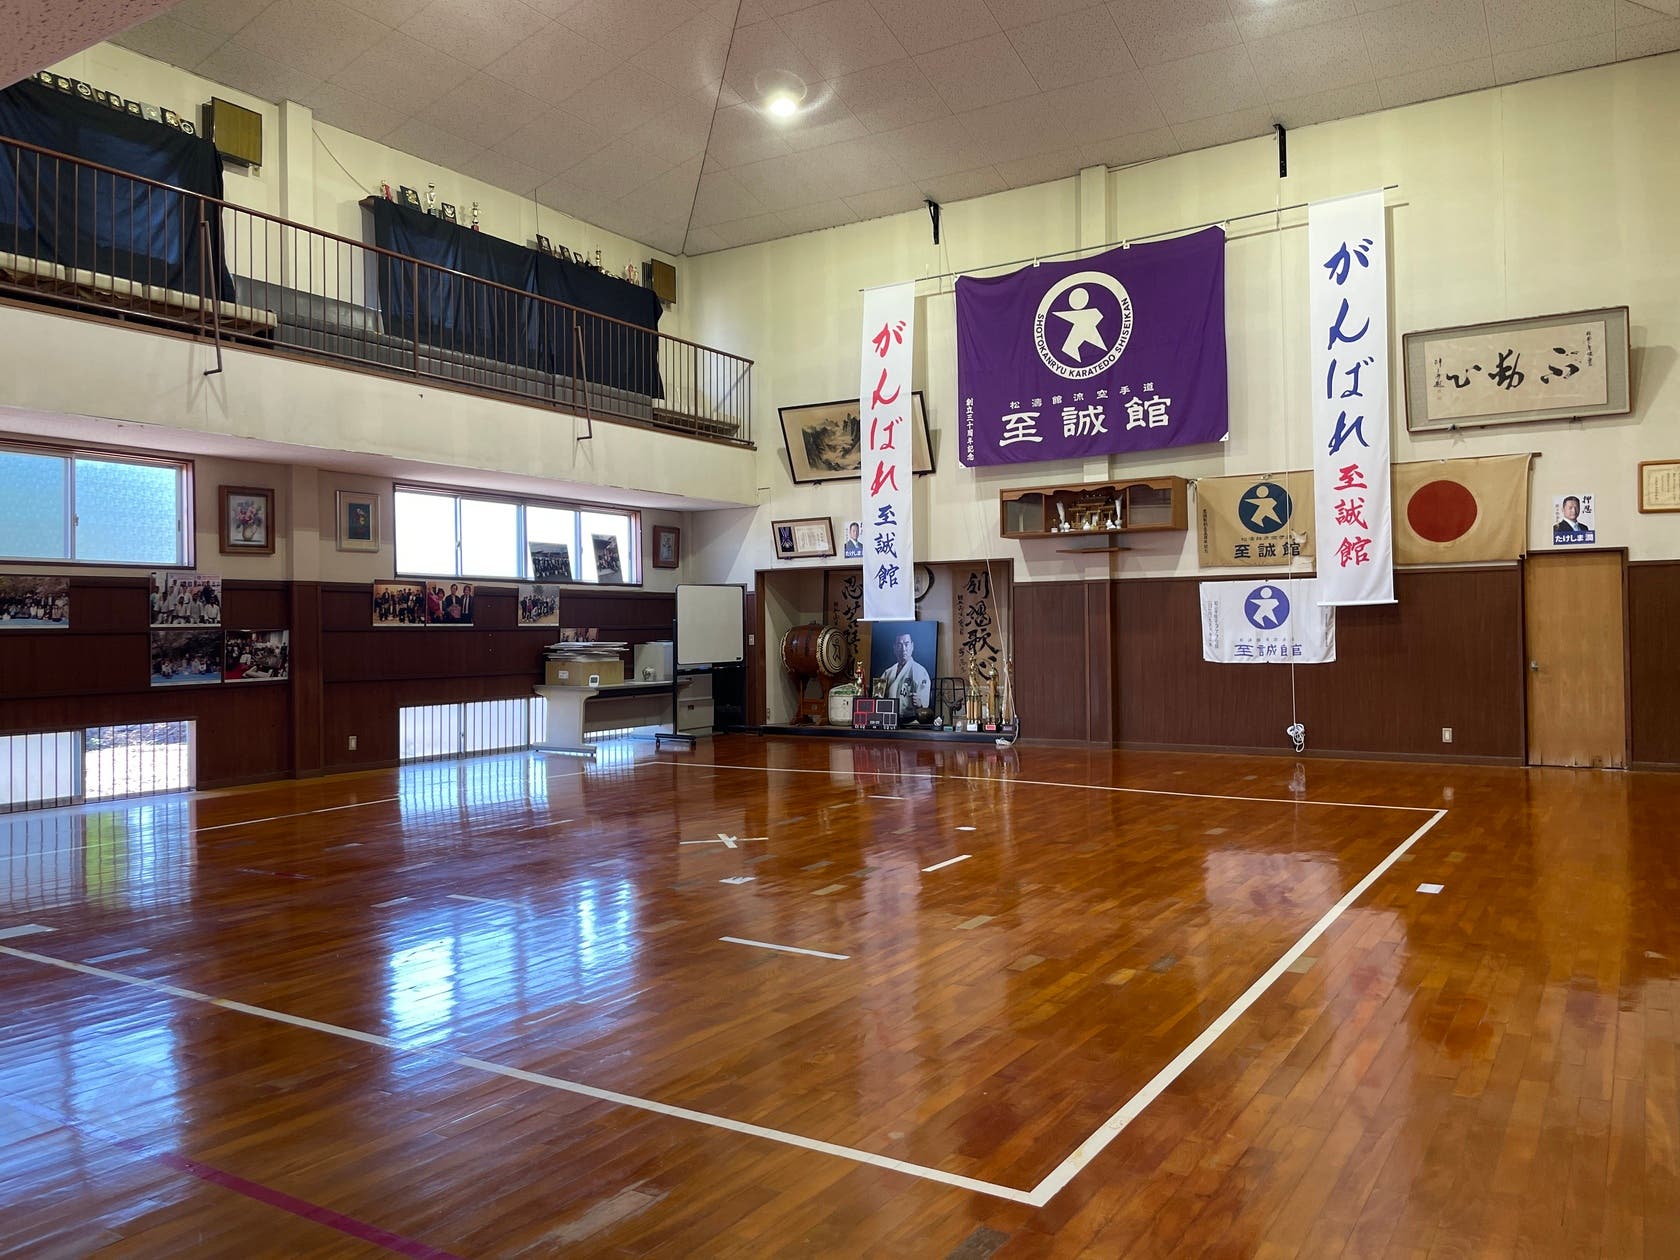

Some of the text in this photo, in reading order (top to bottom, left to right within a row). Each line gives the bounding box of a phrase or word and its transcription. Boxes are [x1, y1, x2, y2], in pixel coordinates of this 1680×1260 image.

[1035, 297, 1132, 378] SHOTOKANRYU KARATEDO SHISEIKAN
[999, 395, 1172, 447] 至誠館
[1233, 541, 1301, 559] 至誠館
[1233, 643, 1303, 657] 至誠館
